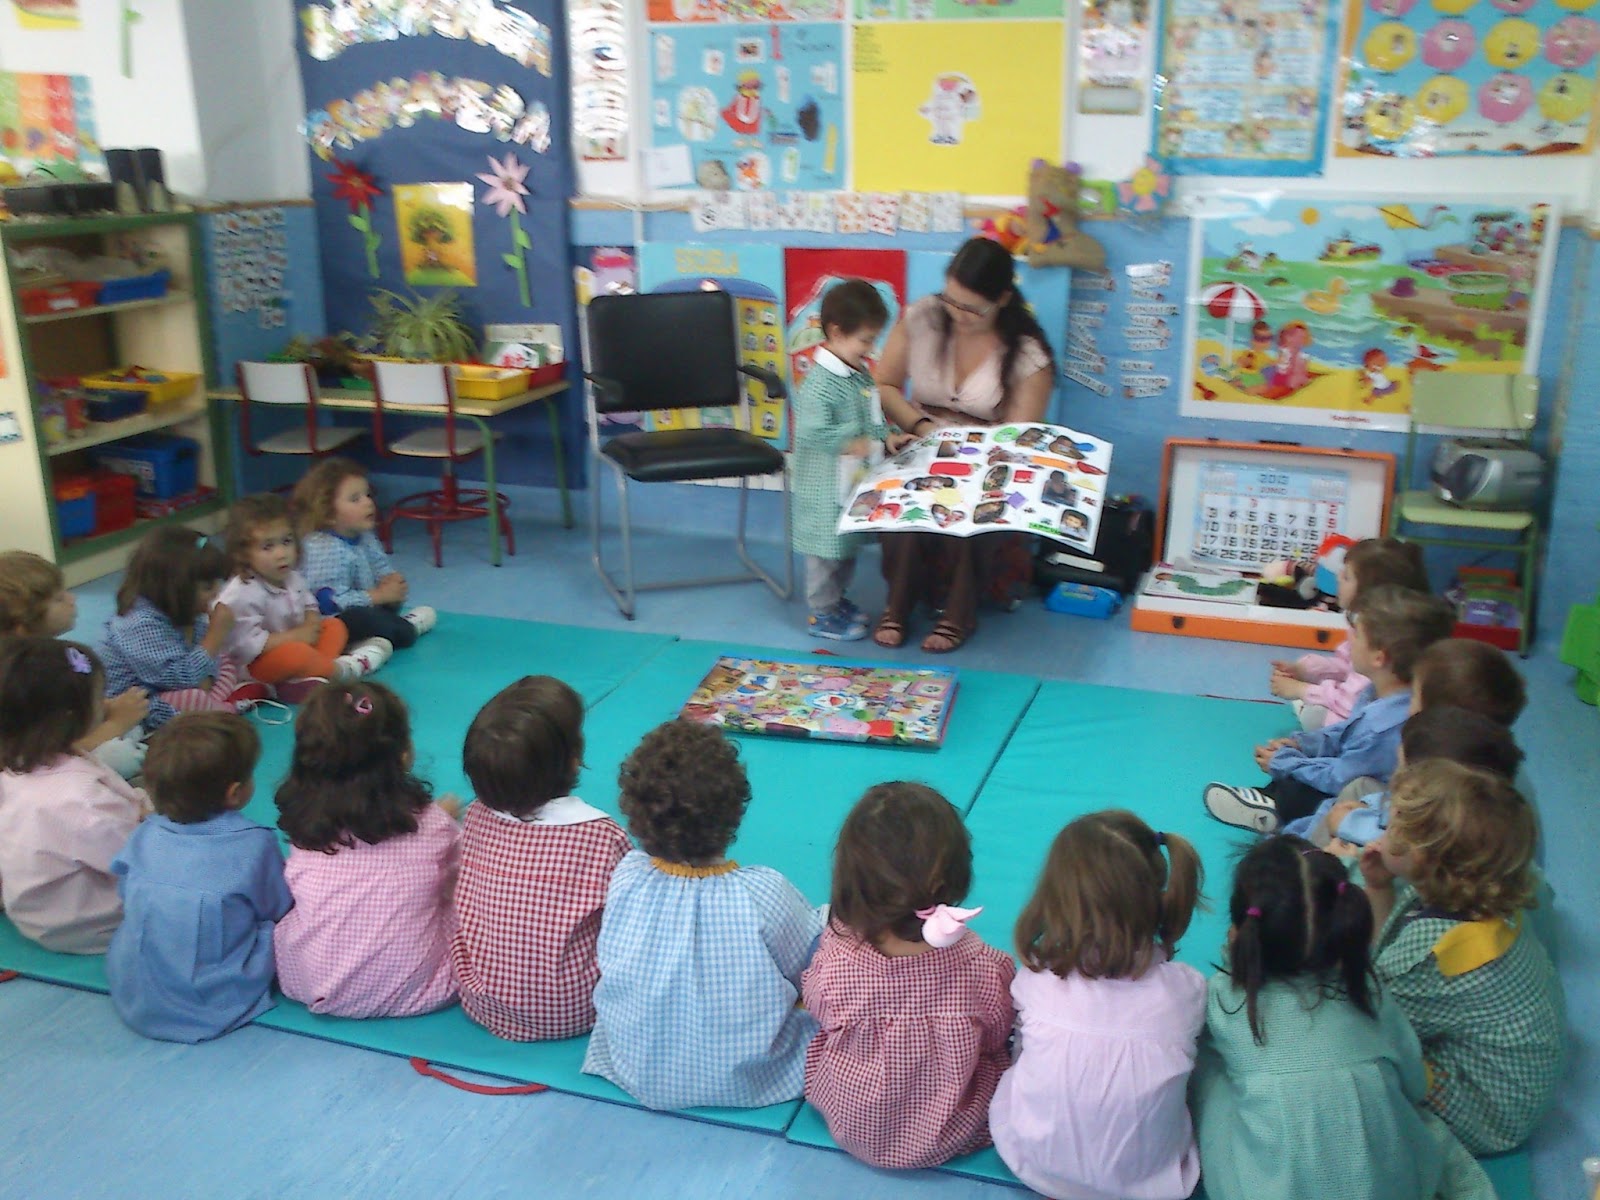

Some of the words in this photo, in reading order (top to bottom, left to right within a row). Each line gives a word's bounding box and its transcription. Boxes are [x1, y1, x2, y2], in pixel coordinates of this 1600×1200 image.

[1245, 524, 1259, 536] 12
[1203, 534, 1218, 545] 17
[1260, 539, 1279, 551] 20
[1220, 549, 1238, 560] 25
[1240, 551, 1258, 562] 26
[1260, 552, 1278, 563] 27
